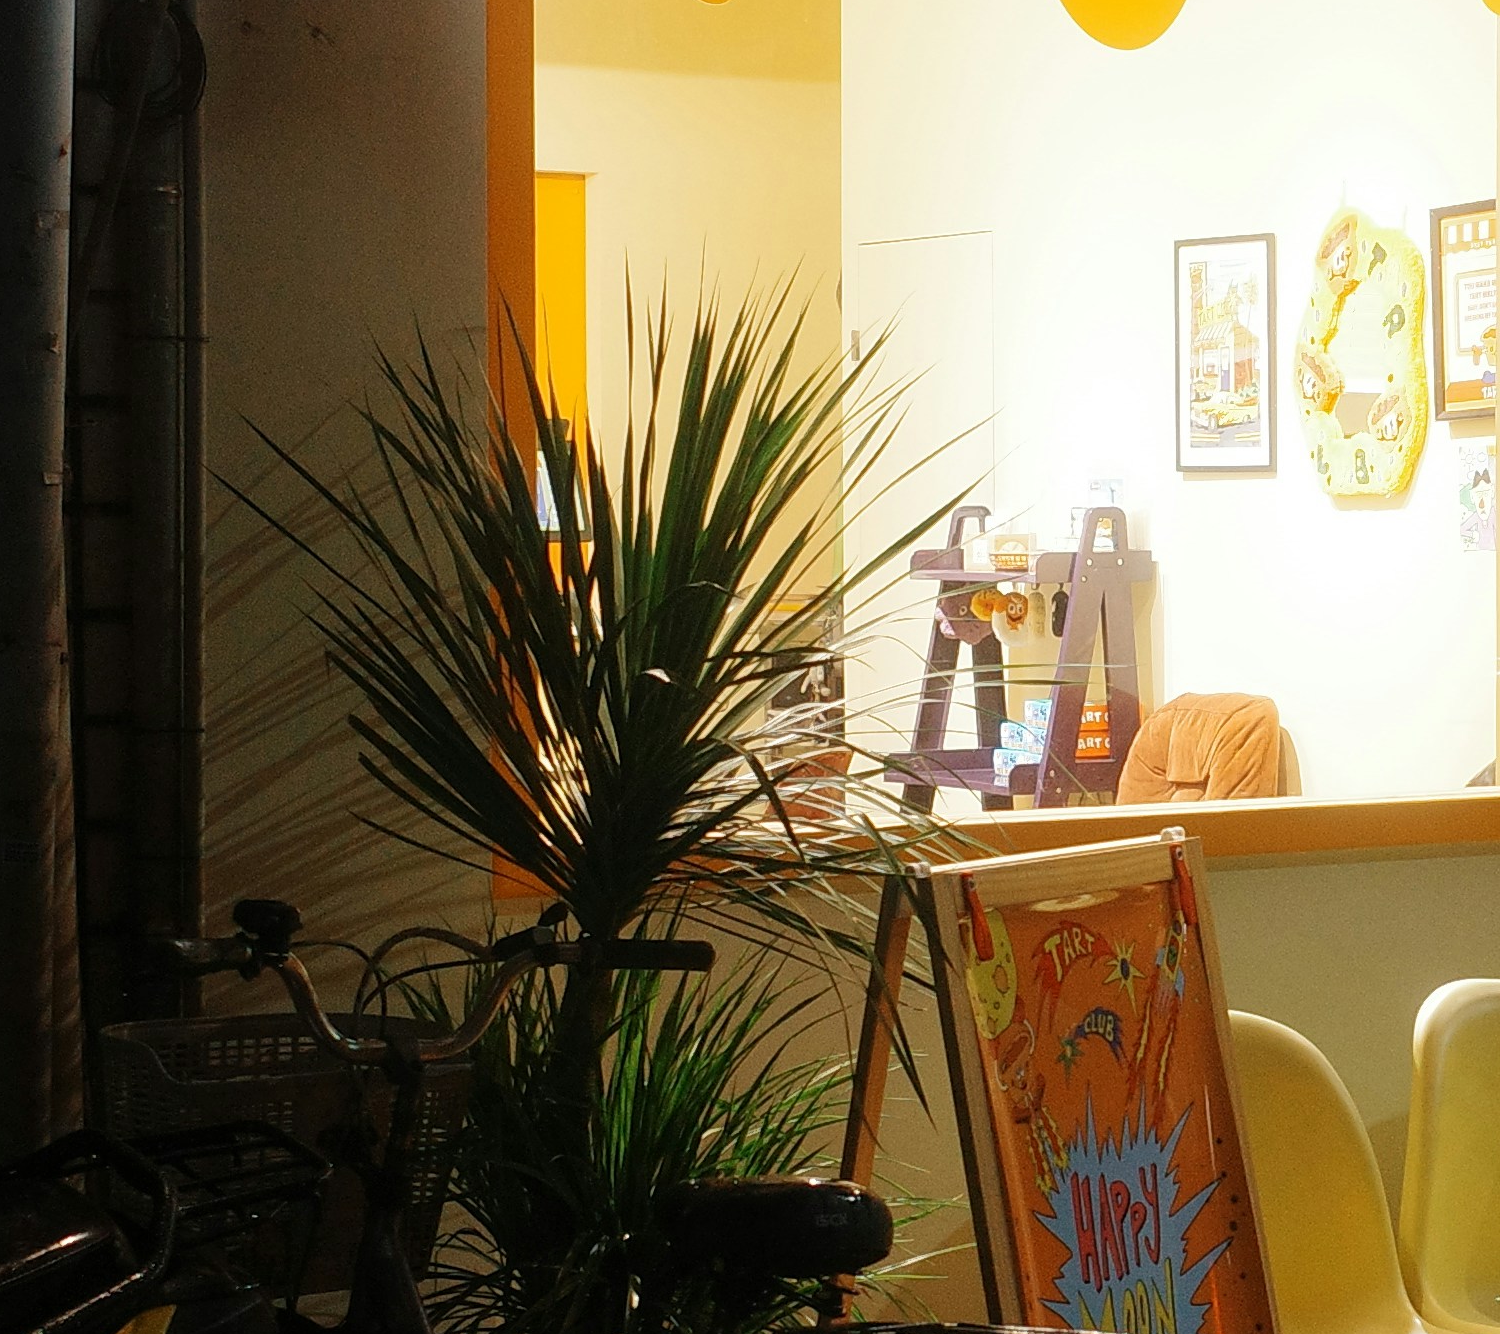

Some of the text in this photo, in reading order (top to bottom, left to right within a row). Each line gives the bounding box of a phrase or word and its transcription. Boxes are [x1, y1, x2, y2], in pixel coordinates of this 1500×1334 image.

[1044, 927, 1096, 983] TART
[1083, 1013, 1115, 1042] CLUB
[1070, 1162, 1161, 1293] HAPPY
